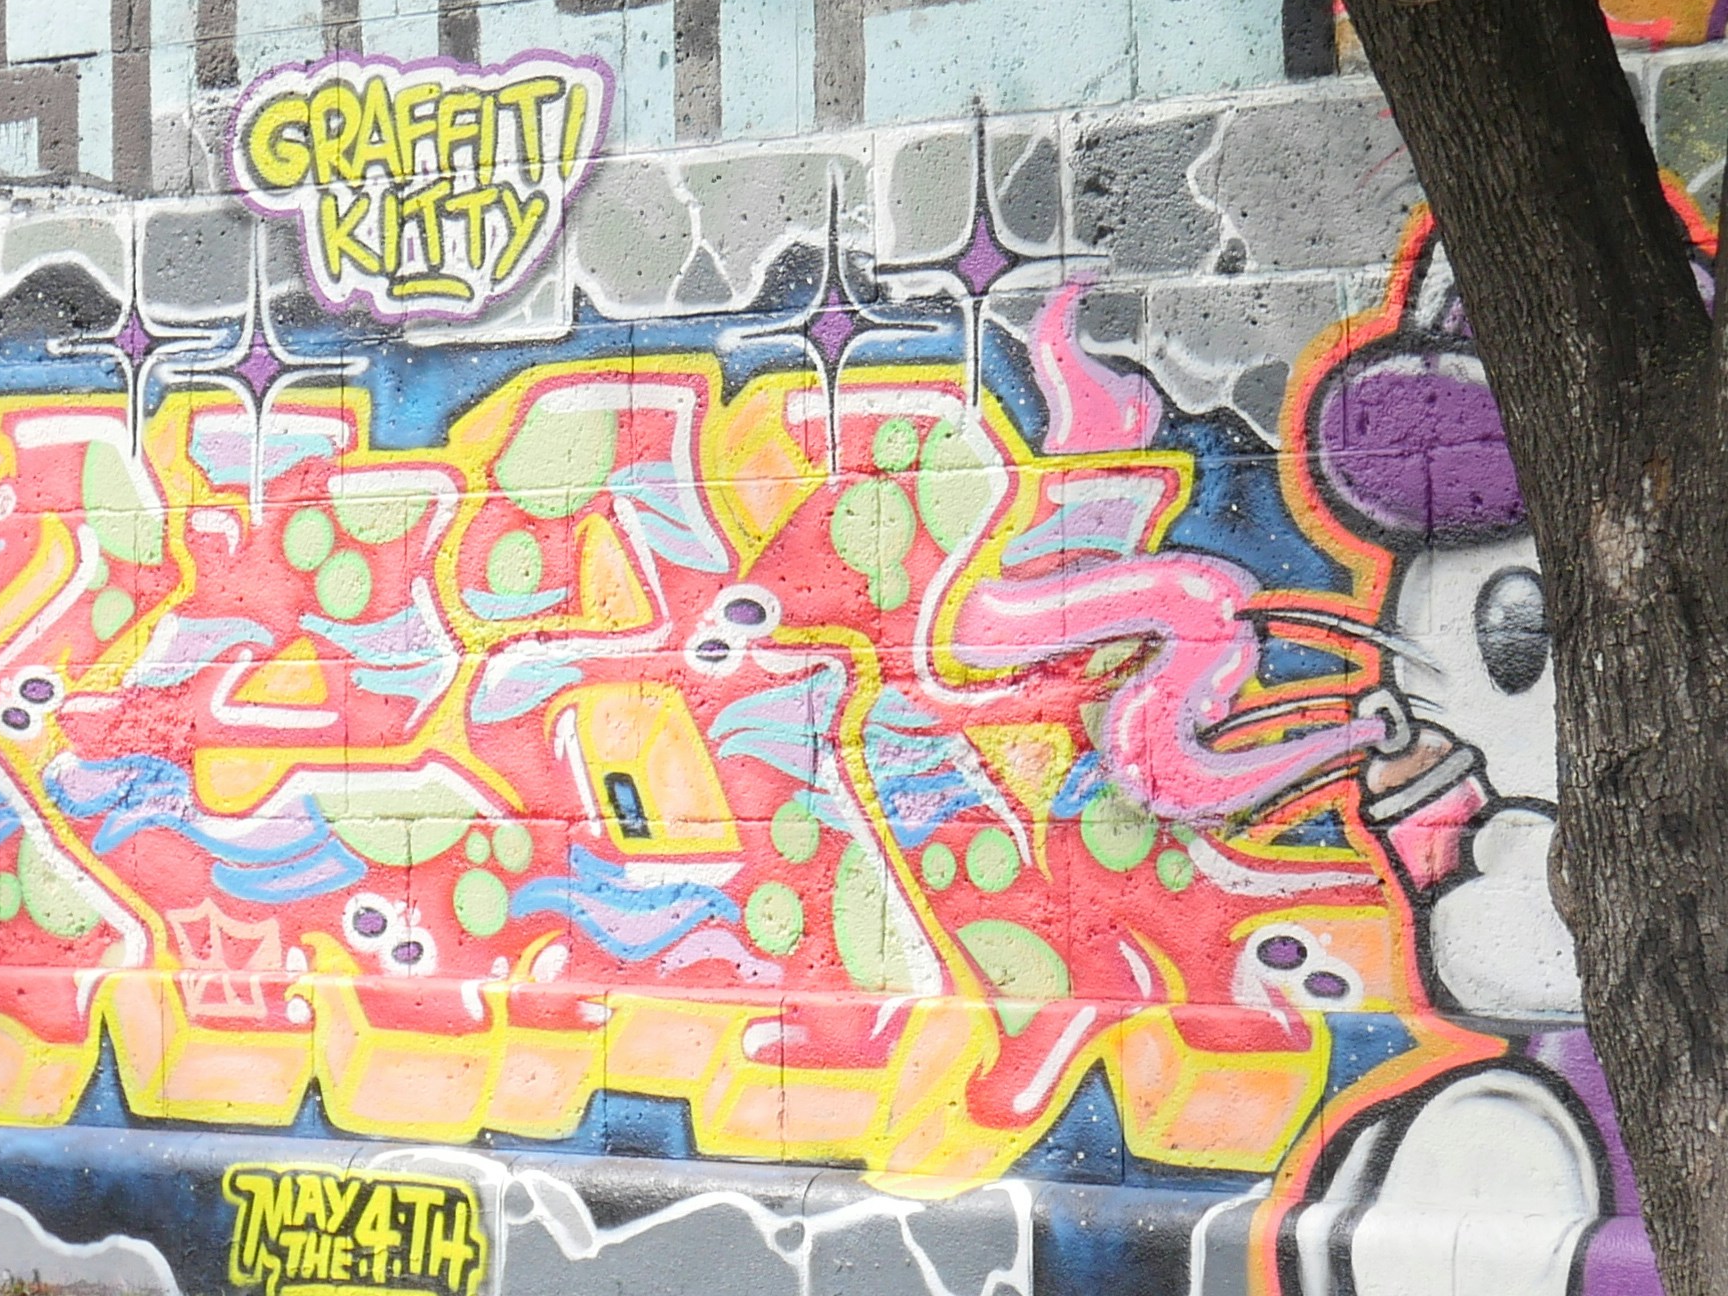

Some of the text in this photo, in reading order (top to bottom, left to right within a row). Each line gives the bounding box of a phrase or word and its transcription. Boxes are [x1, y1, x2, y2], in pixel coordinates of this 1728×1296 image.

[248, 75, 586, 186] GRAFFITI
[319, 182, 544, 278] KITTY
[235, 1174, 362, 1267] MAY
[278, 1230, 354, 1281] THE
